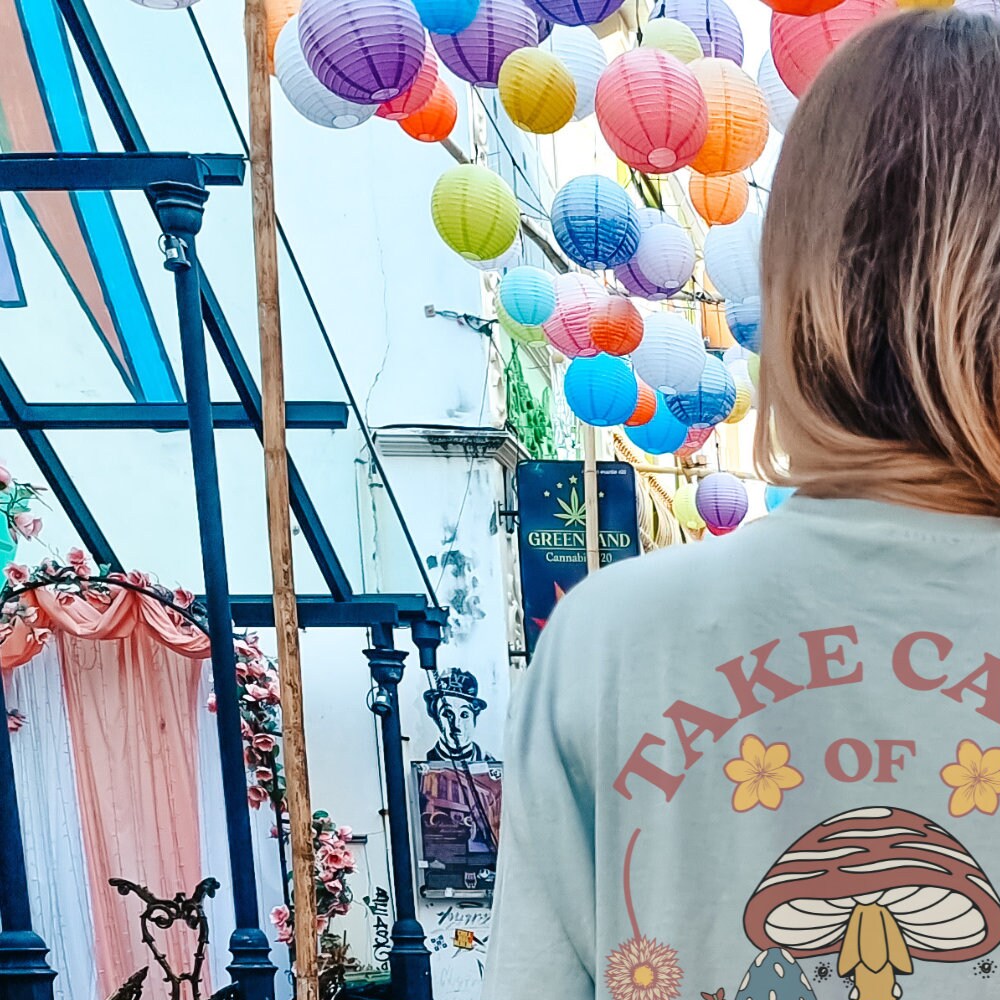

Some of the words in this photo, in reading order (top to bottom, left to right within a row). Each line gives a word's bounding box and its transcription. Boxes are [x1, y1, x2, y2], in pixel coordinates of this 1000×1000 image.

[528, 532, 631, 548] GREENAND
[545, 551, 588, 563] Cannabi
[613, 625, 864, 804] TAKE
[824, 738, 917, 784] OF
